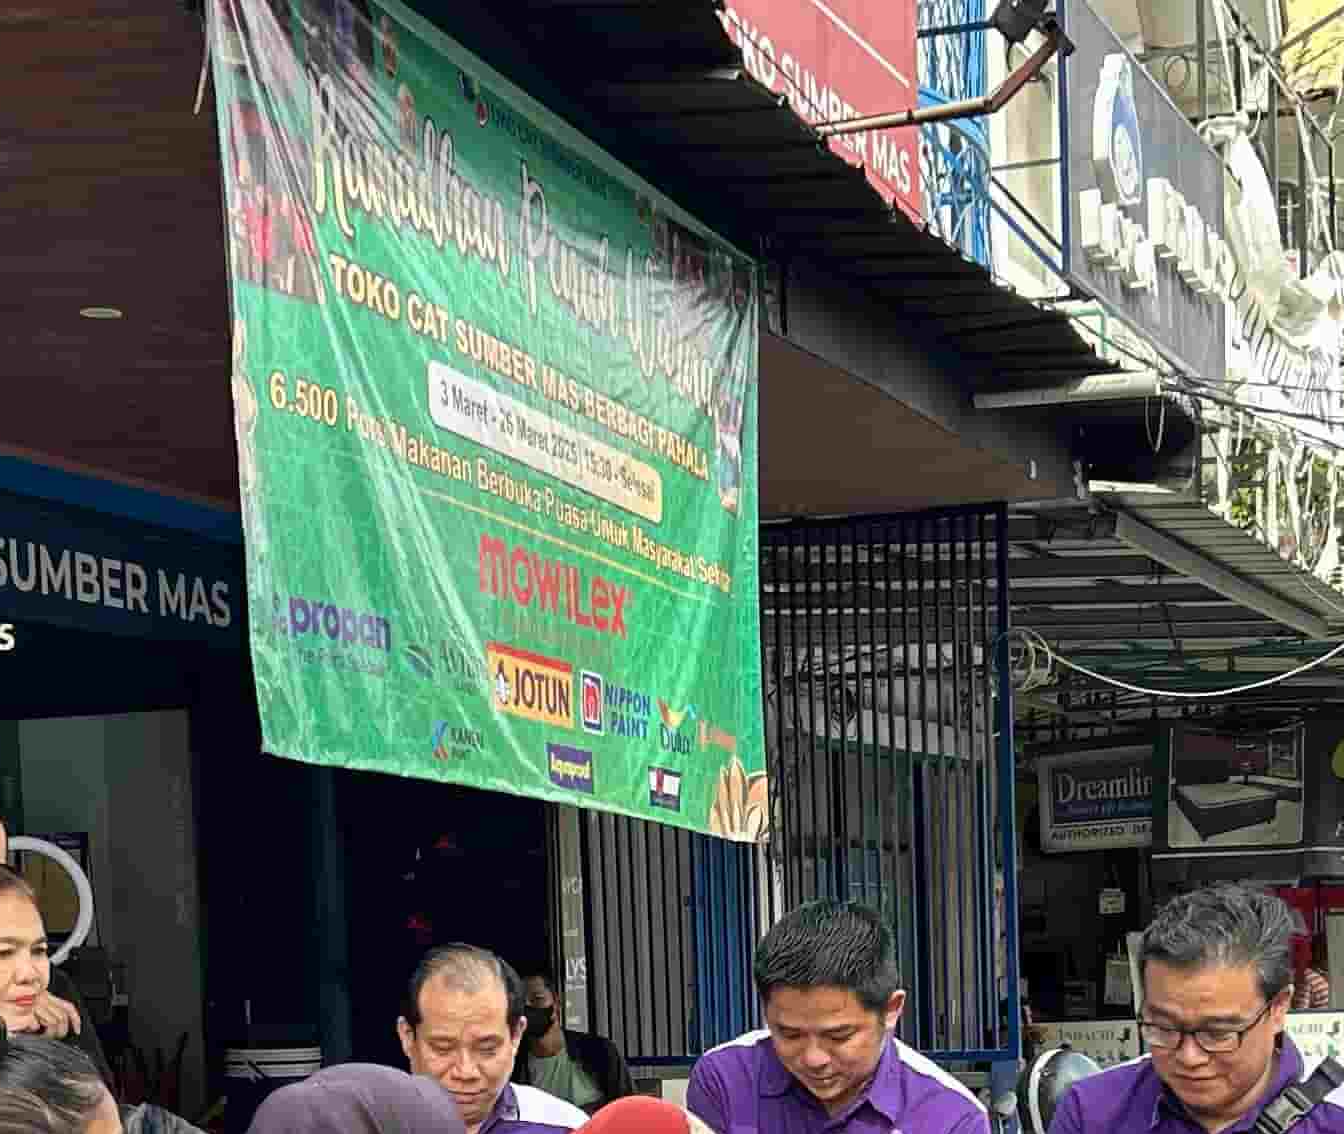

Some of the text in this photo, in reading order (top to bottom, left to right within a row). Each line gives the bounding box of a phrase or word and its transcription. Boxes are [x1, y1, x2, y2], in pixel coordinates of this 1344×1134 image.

[871, 130, 910, 193] MAS
[329, 253, 401, 320] TOKO
[407, 293, 449, 343] CAT
[456, 318, 536, 392] SUMBER
[269, 369, 338, 426] 6.500
[390, 424, 472, 483] Makanan
[157, 568, 233, 628] MAS
[512, 666, 571, 718] JOTUN
